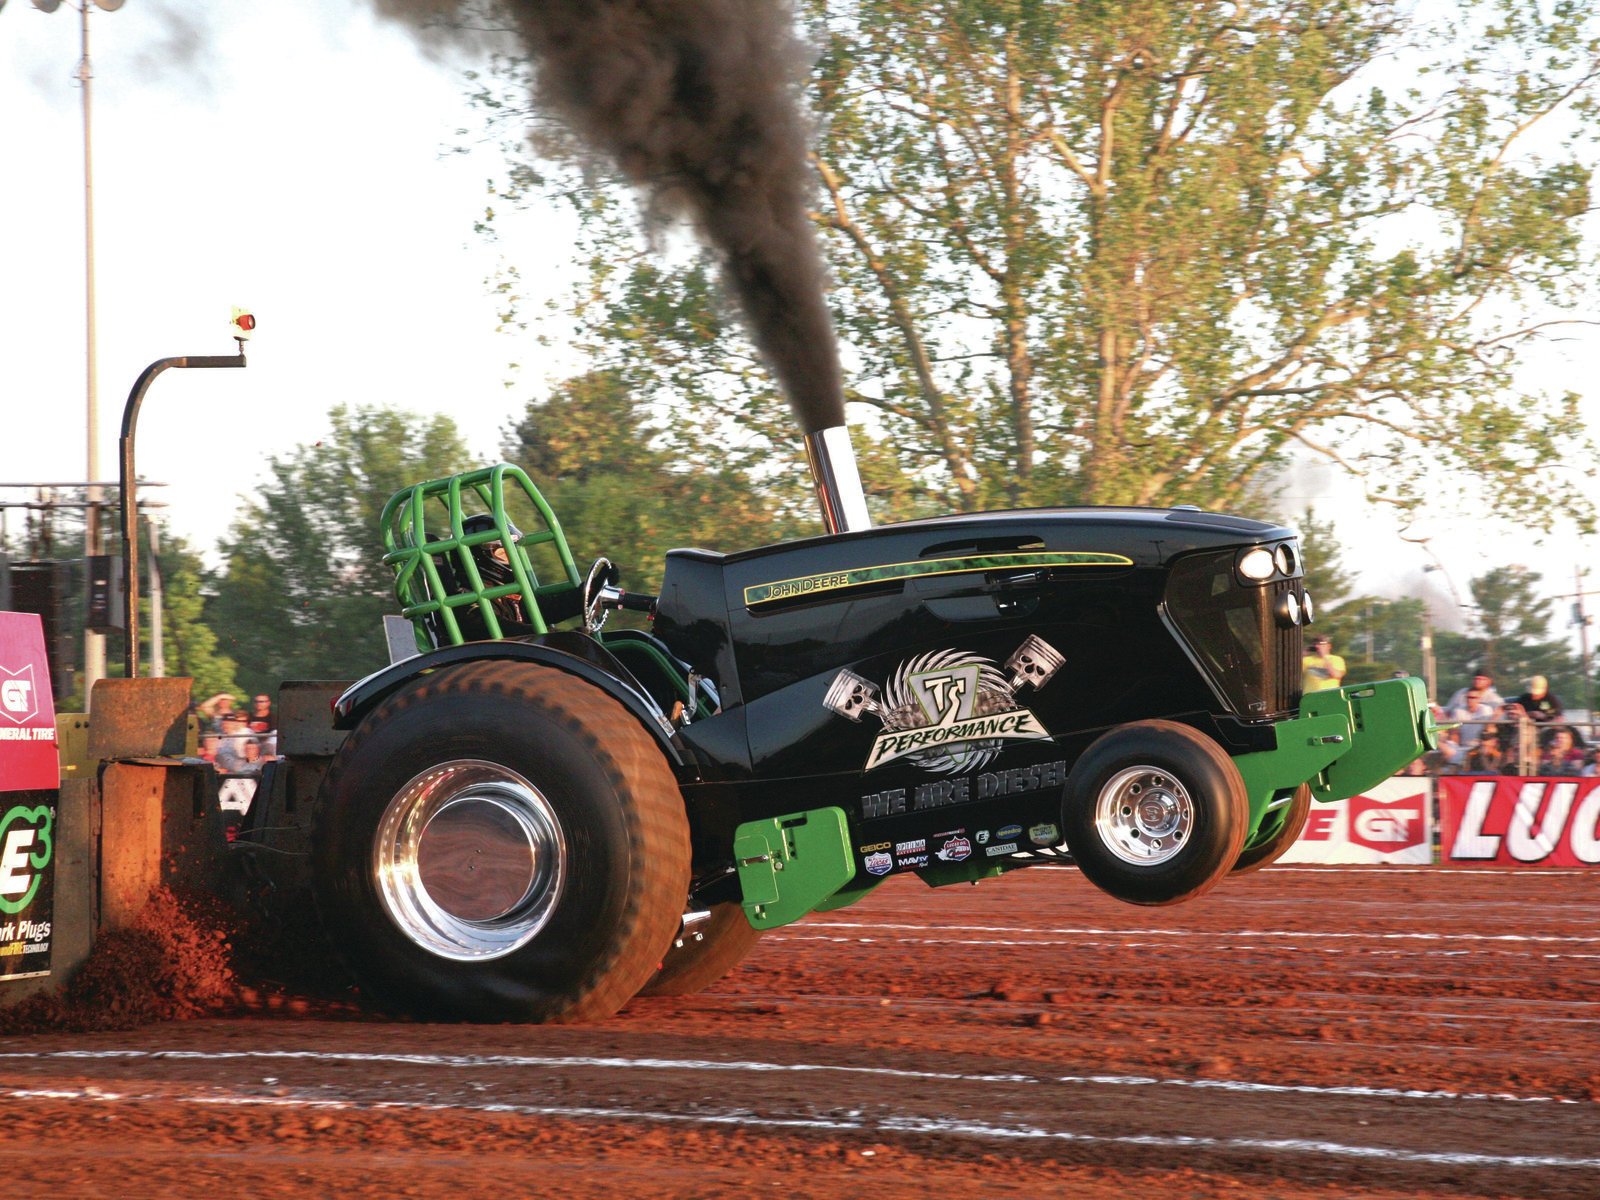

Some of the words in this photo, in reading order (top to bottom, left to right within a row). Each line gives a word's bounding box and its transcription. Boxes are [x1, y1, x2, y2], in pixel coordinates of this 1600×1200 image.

[764, 582, 802, 599] JOHN
[802, 574, 848, 592] DEERE
[2, 680, 31, 712] GT
[32, 727, 55, 741] TIRE
[877, 714, 1034, 761] PERFORMANCE
[861, 788, 906, 819] WE
[914, 777, 970, 811] ARE
[977, 760, 1067, 799] DIESEL
[1354, 808, 1420, 842] GT
[860, 841, 892, 853] GEICO
[17, 920, 51, 942] Plugs
